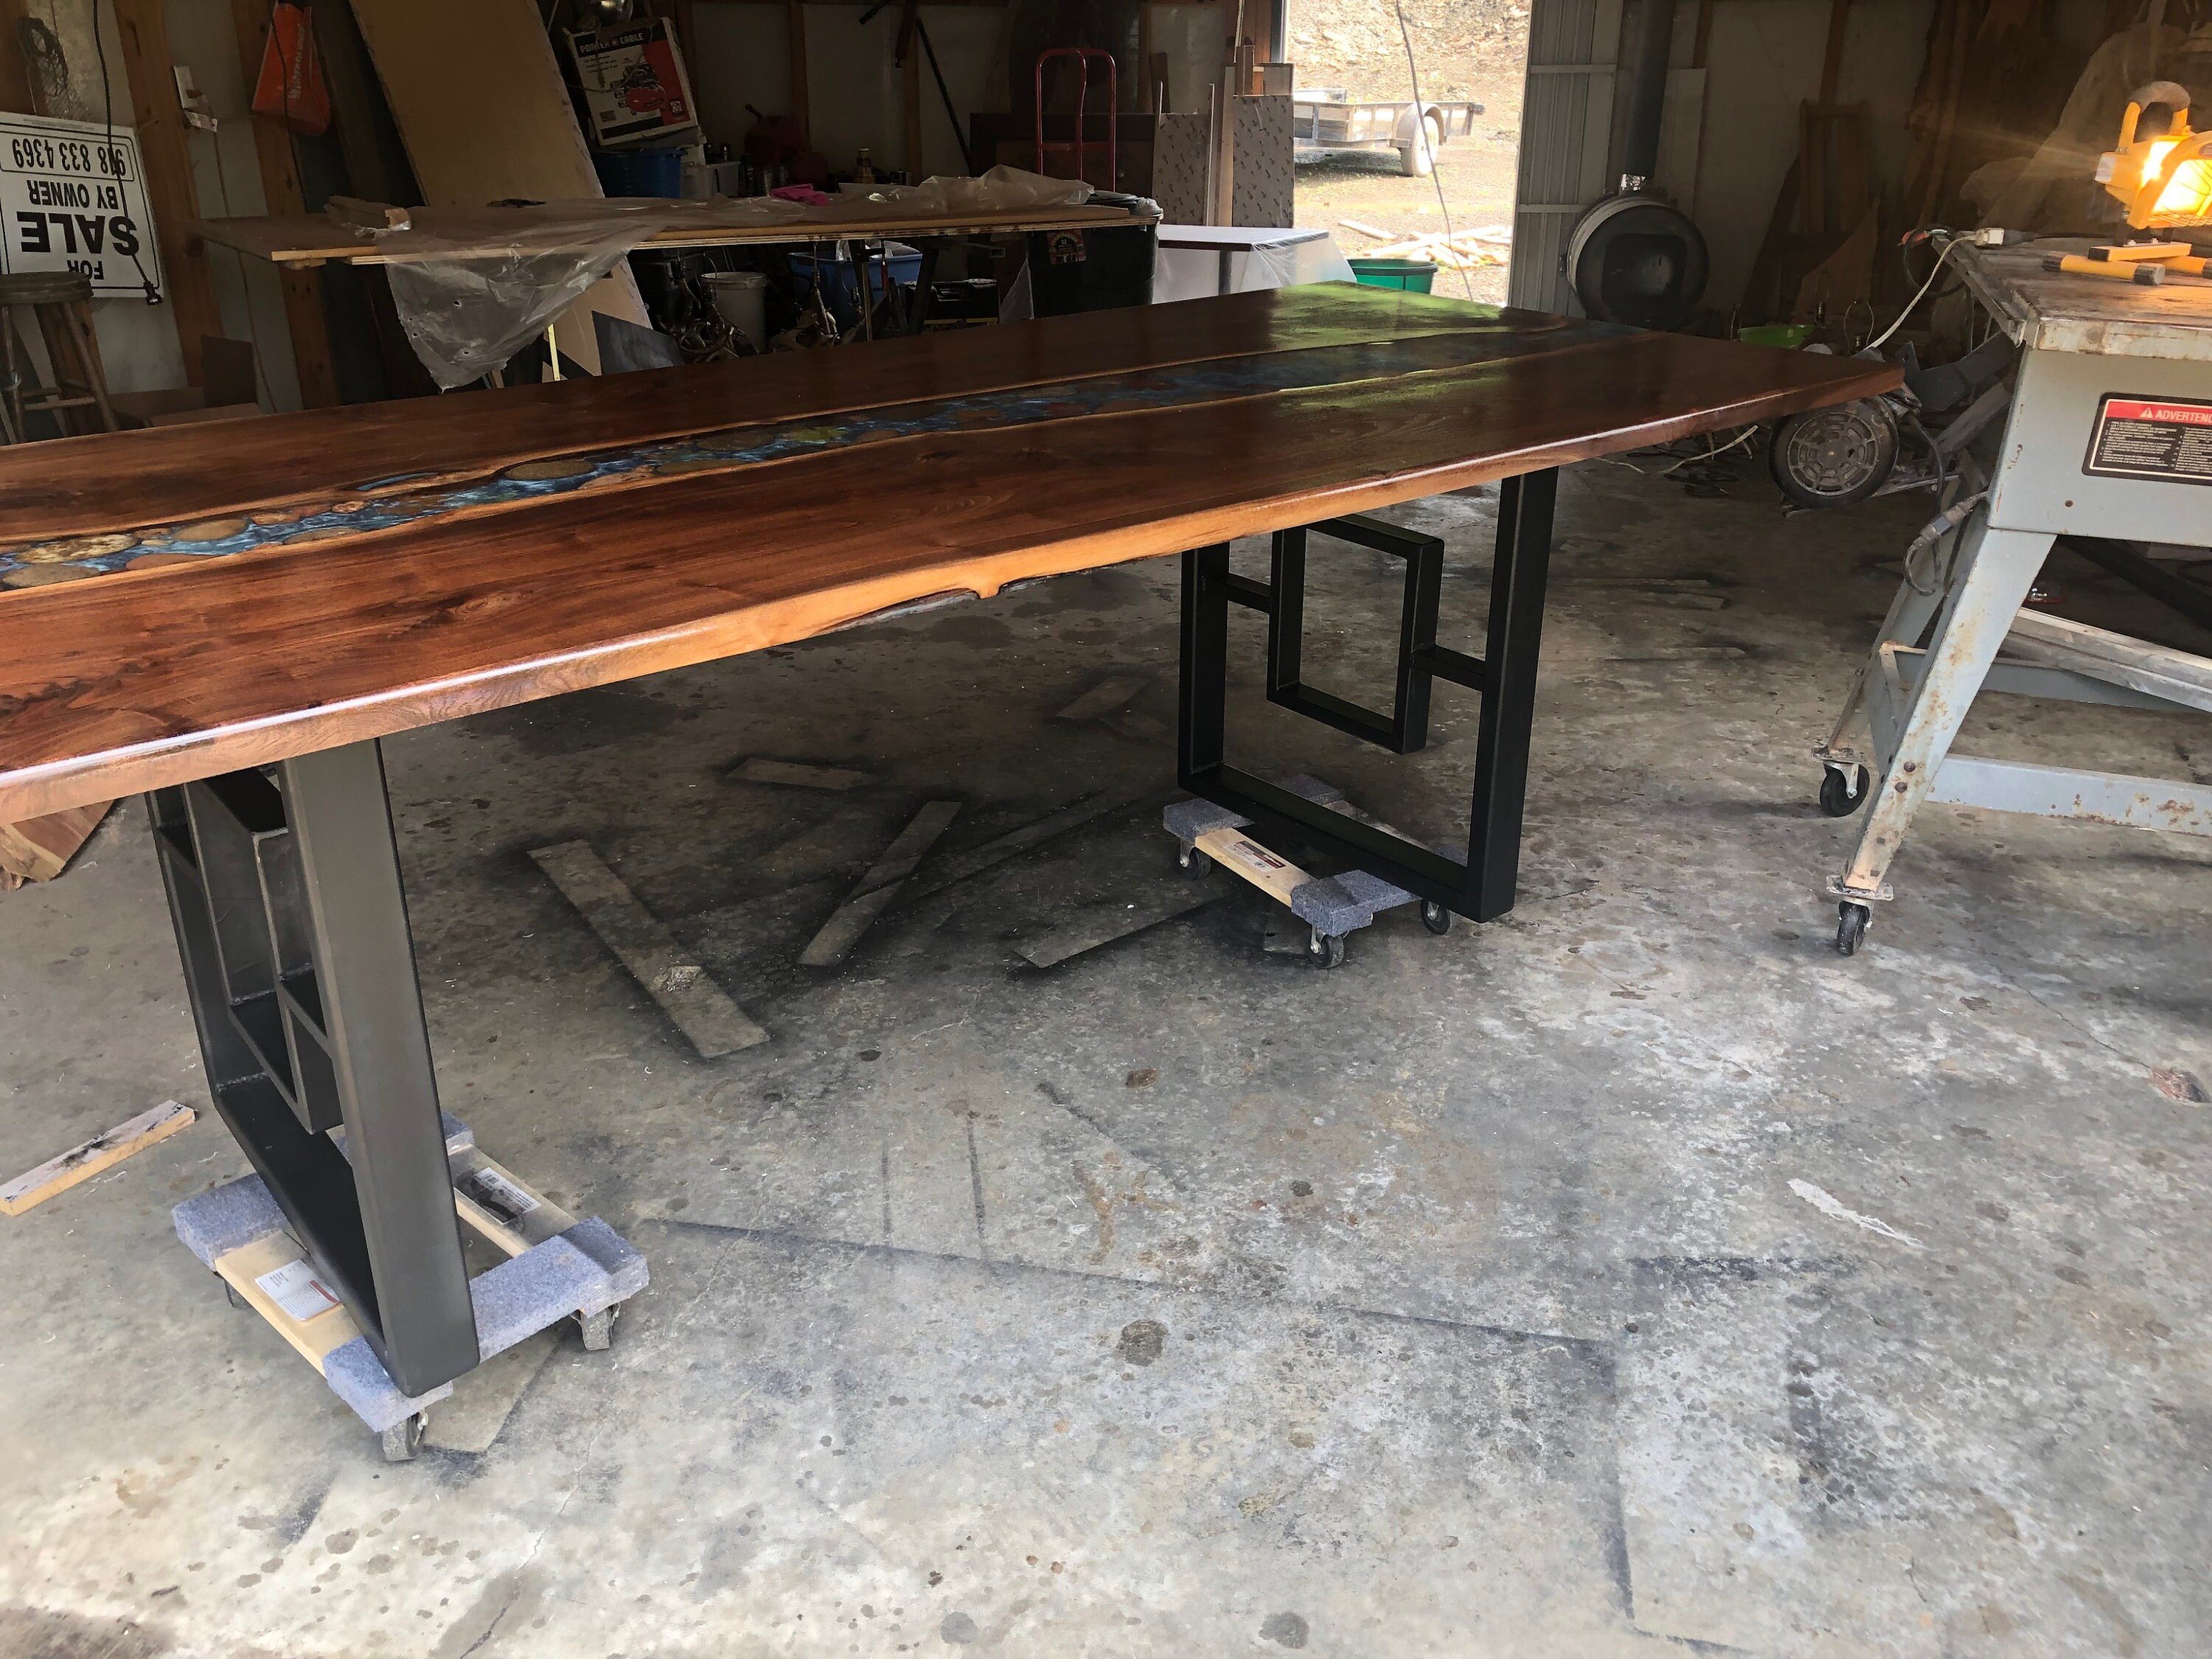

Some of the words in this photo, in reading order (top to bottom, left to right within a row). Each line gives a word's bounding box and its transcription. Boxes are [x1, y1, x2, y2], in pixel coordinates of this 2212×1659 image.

[619, 33, 644, 44] CABLE
[12, 138, 55, 169] 4369
[59, 142, 91, 172] 833
[27, 180, 90, 209] OWNER
[96, 185, 119, 209] BY
[16, 211, 139, 256] SALE
